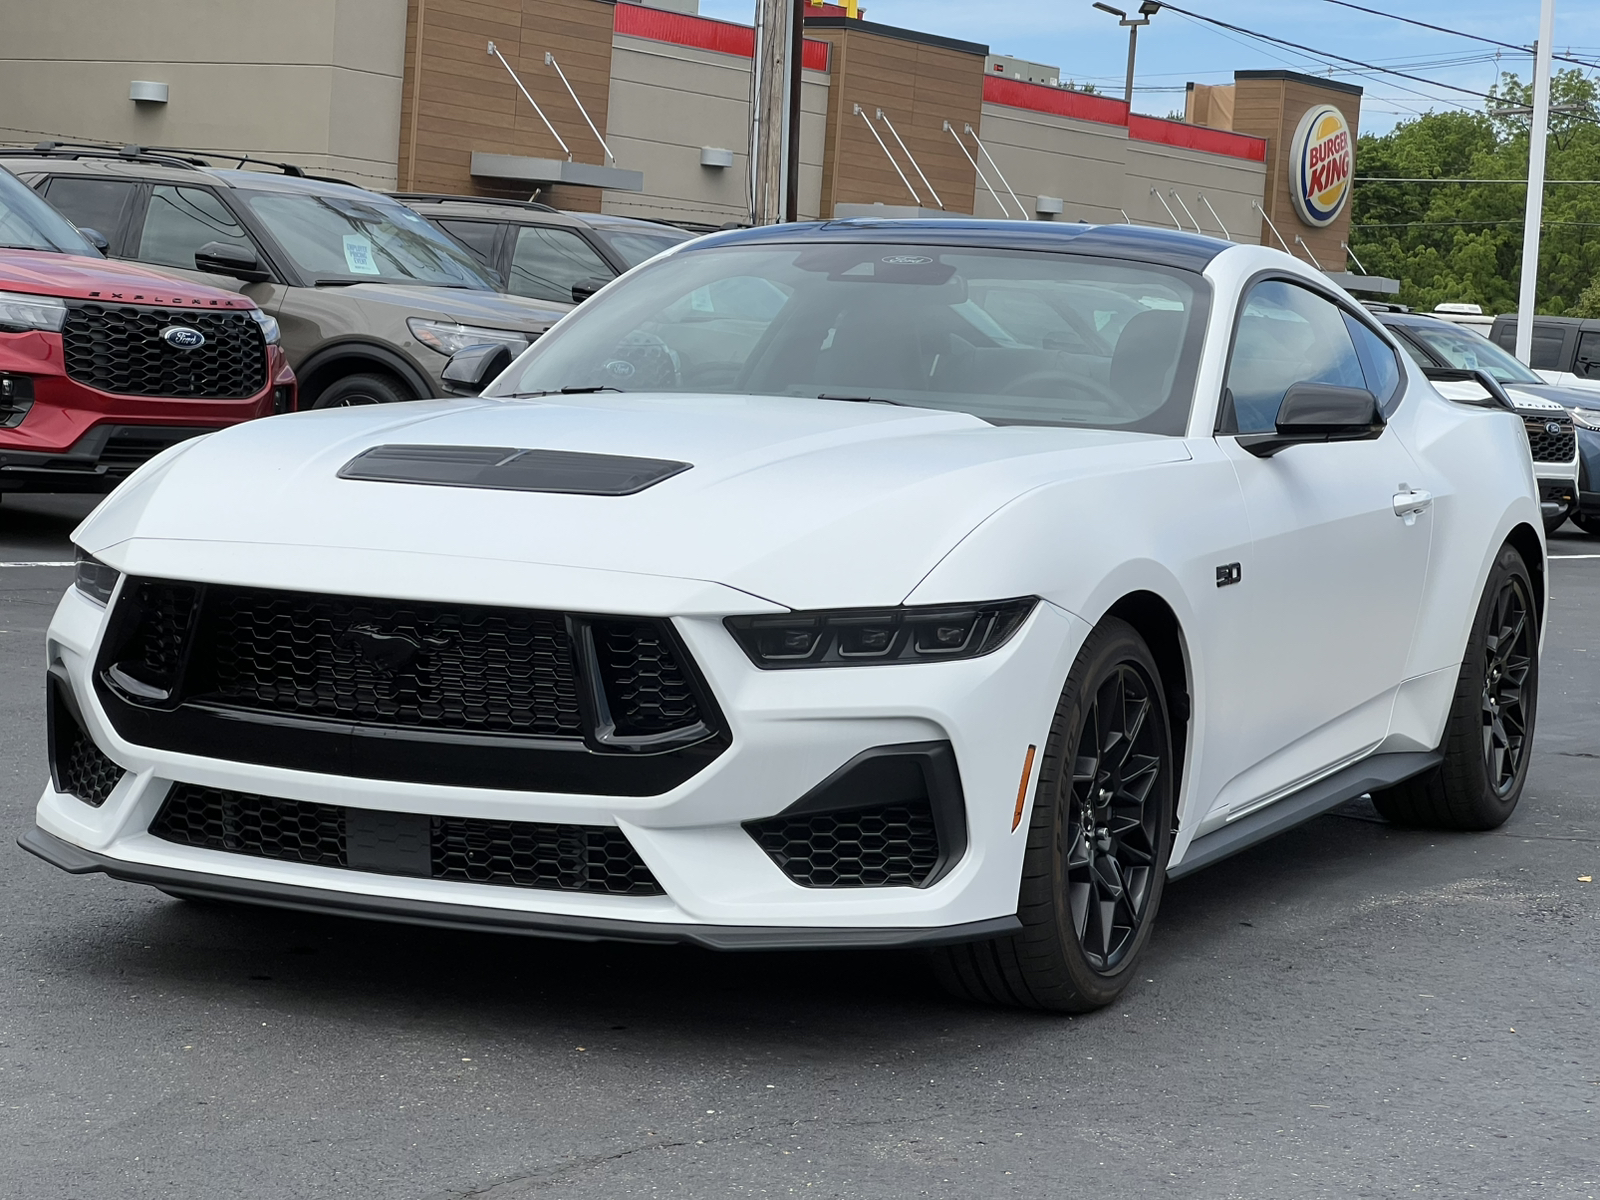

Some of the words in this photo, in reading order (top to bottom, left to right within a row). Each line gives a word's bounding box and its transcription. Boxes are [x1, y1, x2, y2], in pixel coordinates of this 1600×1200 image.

[1309, 131, 1348, 169] BURGER
[1307, 149, 1350, 198] KING
[889, 255, 925, 264] Ford
[88, 291, 234, 306] EXPLORER
[175, 332, 197, 344] Ford
